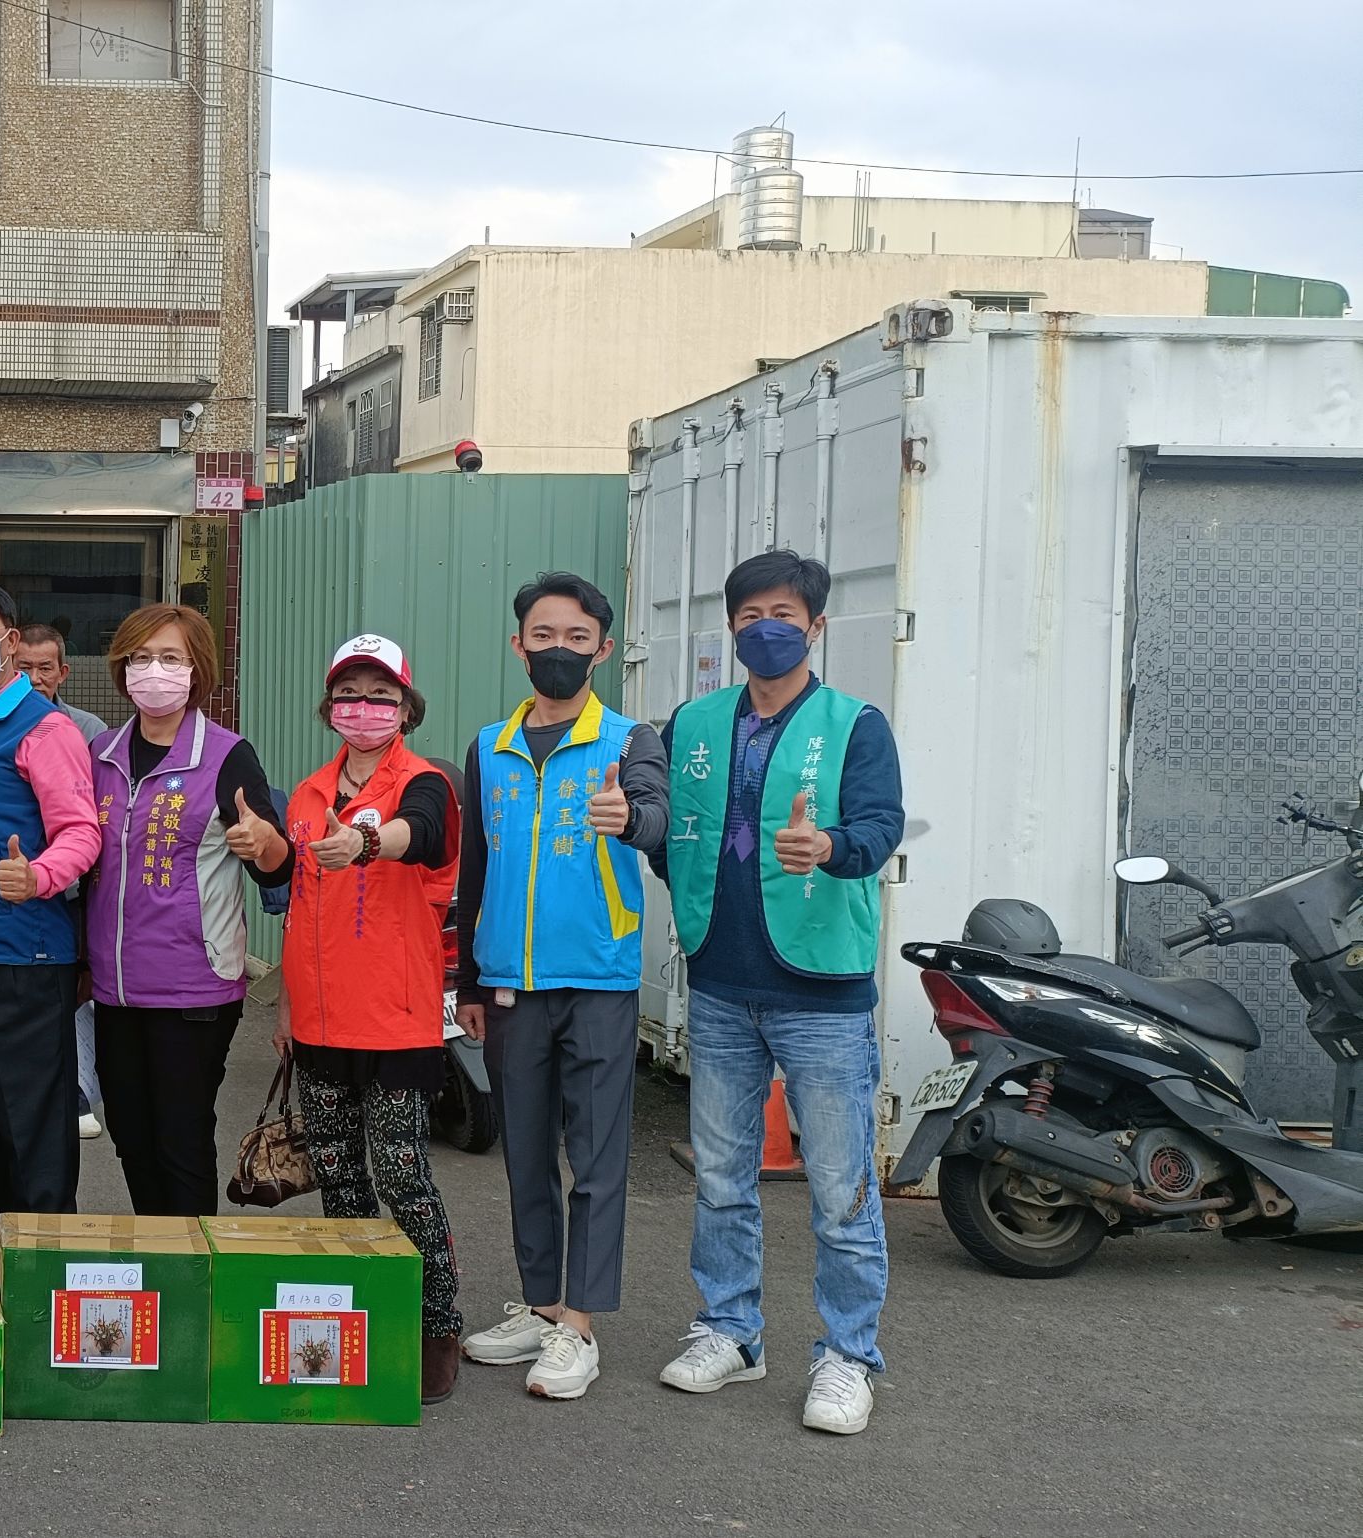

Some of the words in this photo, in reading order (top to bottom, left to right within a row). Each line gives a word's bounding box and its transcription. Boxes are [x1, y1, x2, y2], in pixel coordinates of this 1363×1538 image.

[210, 492, 234, 507] 42
[191, 524, 202, 560] 龍潭區
[207, 524, 218, 560] 桃園市
[672, 742, 712, 841] 志工
[142, 793, 167, 886] 感恩服務團隊
[160, 794, 185, 887] 黃敬平議員
[71, 1273, 117, 1286] 1月13日
[280, 1294, 321, 1305] 1月13日
